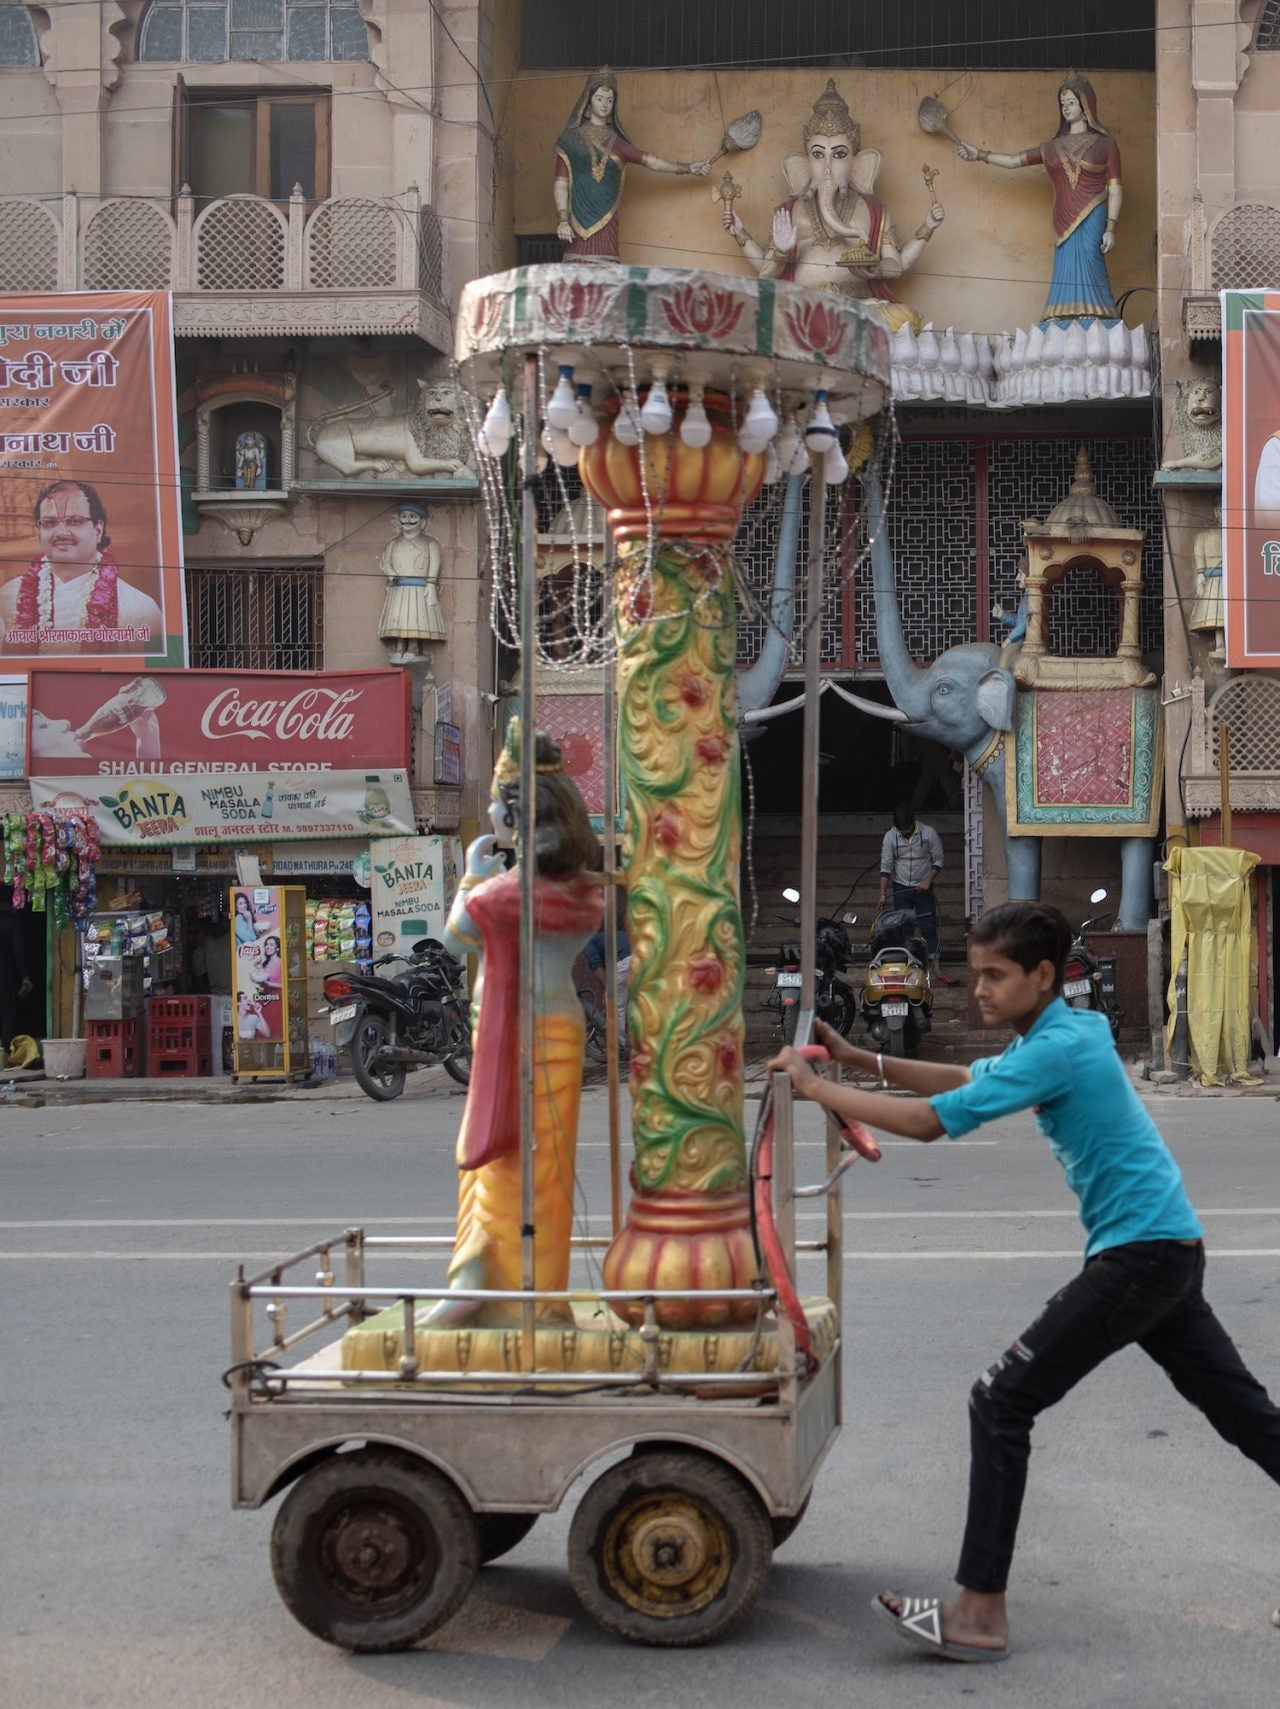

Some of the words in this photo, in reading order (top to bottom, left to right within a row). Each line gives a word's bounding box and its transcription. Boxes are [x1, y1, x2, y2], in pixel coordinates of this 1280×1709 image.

[33, 317, 97, 340] नगरी
[100, 317, 126, 340] में
[60, 350, 119, 387] जी
[73, 423, 116, 454] जी
[136, 624, 150, 642] जी
[201, 687, 365, 740] Coca-Cola
[201, 785, 244, 801] NIMBU
[112, 792, 187, 830] BANTA
[209, 797, 261, 810] MASALA
[221, 808, 257, 820] SODA
[137, 816, 180, 840] JEERA
[194, 826, 219, 839] शालू
[222, 823, 256, 835] जनरल
[258, 821, 280, 834] स्टोर
[297, 823, 354, 833] 9897337110
[383, 862, 433, 889] BANTA
[377, 906, 414, 918] MASALA
[414, 902, 441, 913] SODA
[395, 896, 420, 908] NIMBU
[254, 993, 280, 1001] Doritos
